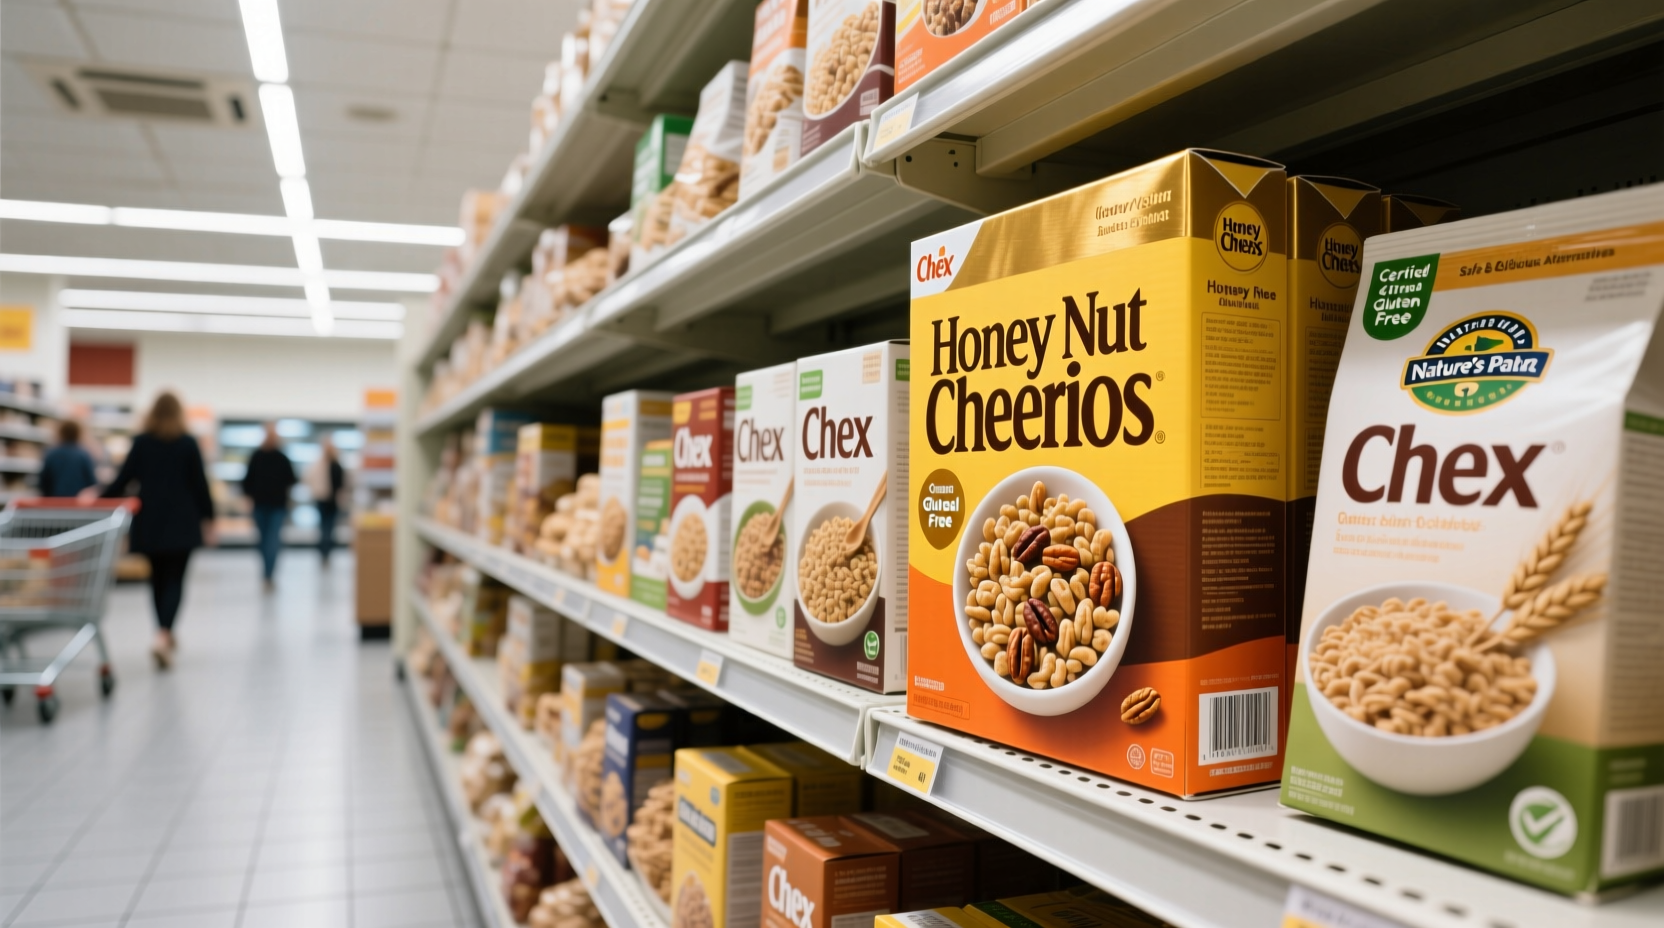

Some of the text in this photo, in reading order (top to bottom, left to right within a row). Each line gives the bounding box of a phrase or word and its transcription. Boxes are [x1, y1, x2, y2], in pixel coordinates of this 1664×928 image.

[916, 253, 955, 283] Chex
[930, 313, 1057, 381] Honey
[1061, 287, 1148, 360] Nut
[1374, 312, 1412, 326] Free
[1411, 356, 1485, 381] Nature's
[802, 406, 874, 460] Chex
[925, 361, 1155, 456] Cheerios
[673, 426, 714, 469] Chex
[737, 418, 785, 463] Chex
[1341, 423, 1548, 509] Chex
[768, 865, 815, 928] Chex
